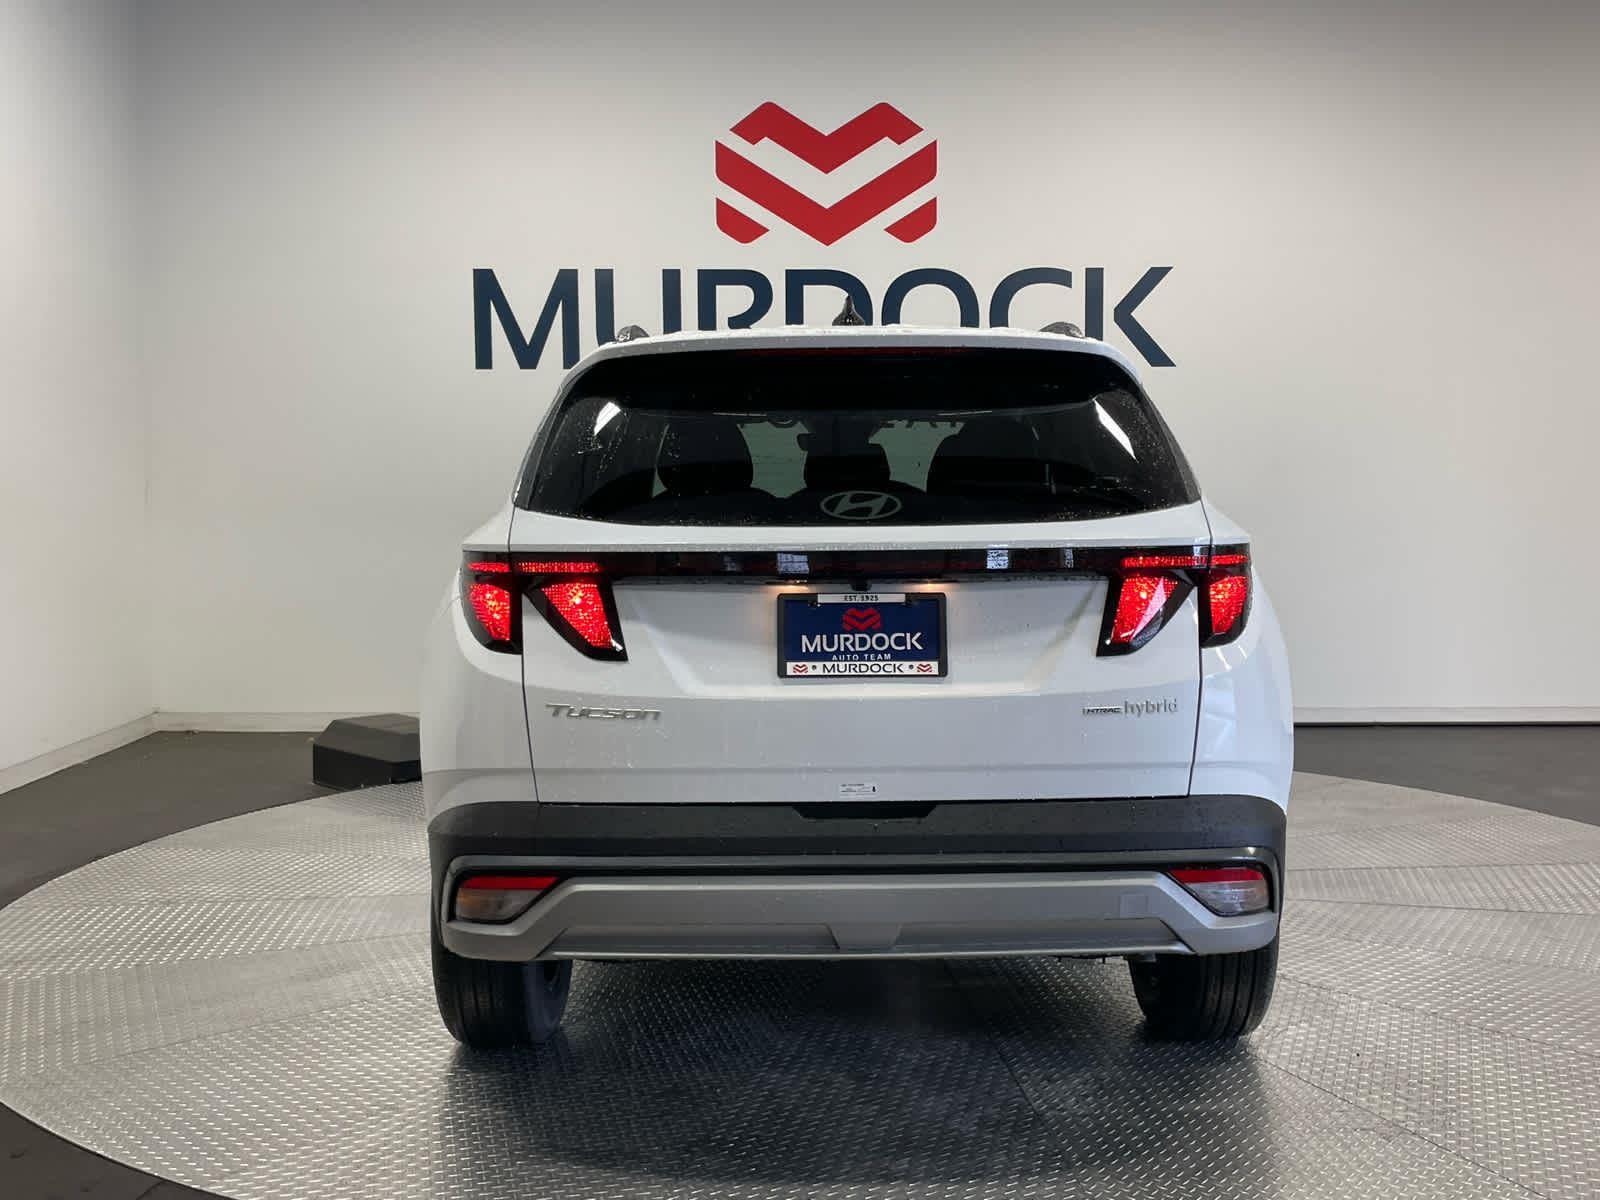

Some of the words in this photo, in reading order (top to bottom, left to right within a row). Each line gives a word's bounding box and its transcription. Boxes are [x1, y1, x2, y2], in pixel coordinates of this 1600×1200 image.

[473, 267, 1176, 370] MURDOCK
[801, 632, 923, 653] MURDOCK
[864, 653, 892, 661] TEAM
[822, 663, 904, 674] MURDOCK
[1124, 698, 1178, 718] hybrid
